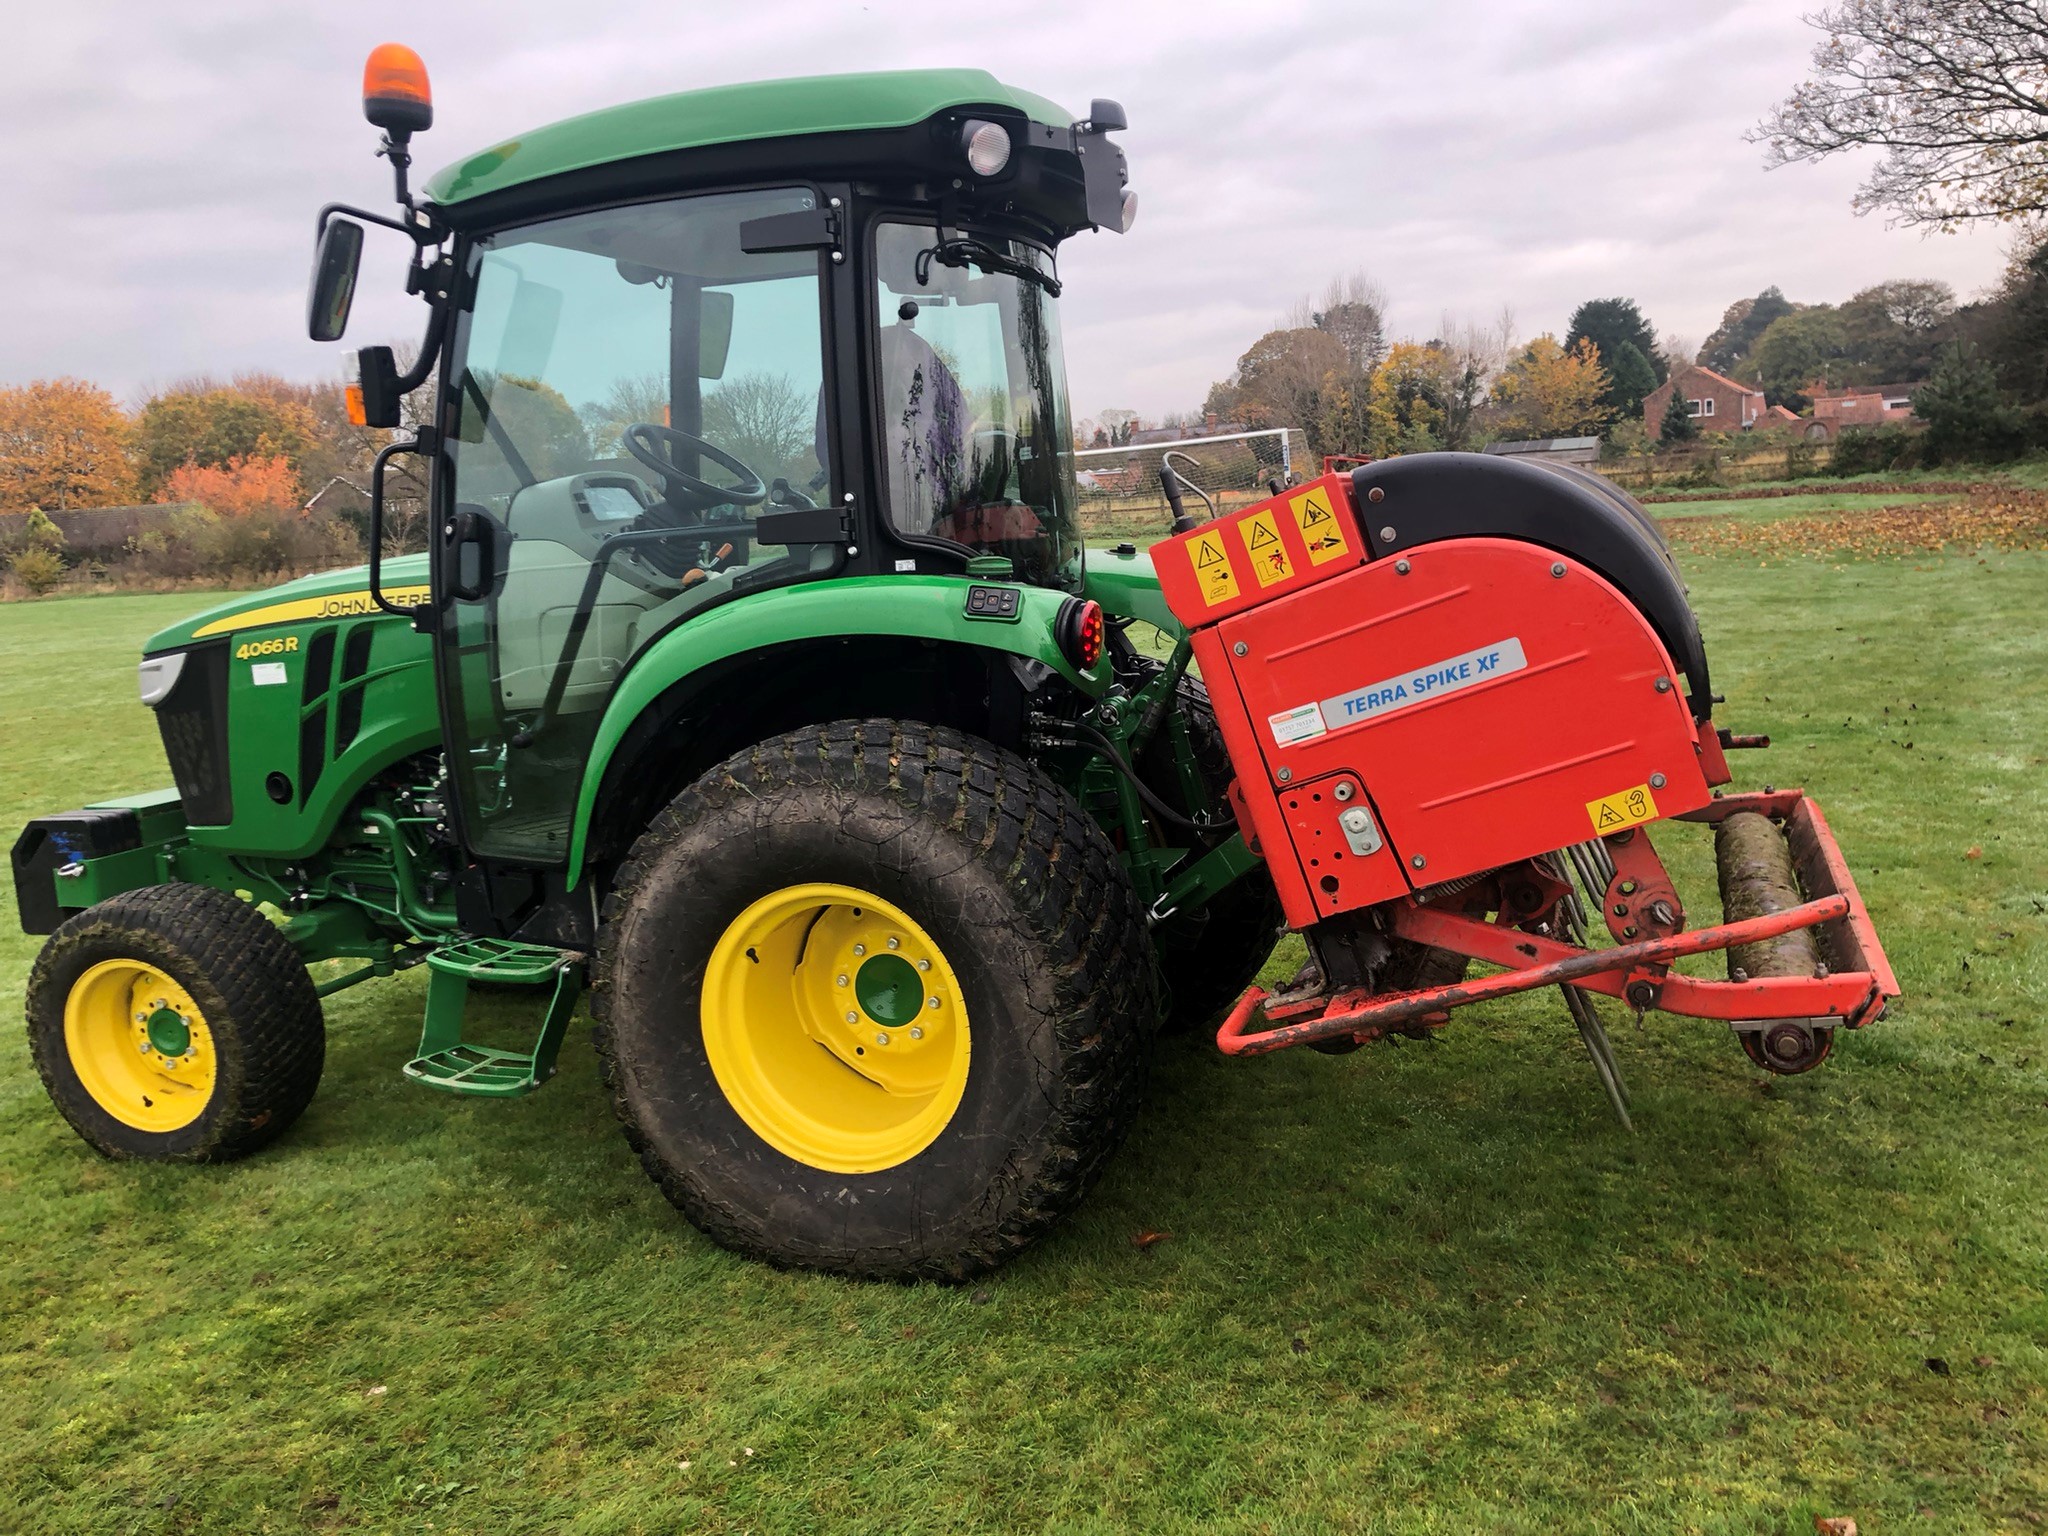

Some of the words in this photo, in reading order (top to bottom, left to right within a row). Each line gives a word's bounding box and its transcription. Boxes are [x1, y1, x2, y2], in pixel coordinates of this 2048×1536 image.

[317, 598, 366, 616] JOHN
[236, 636, 299, 660] 4066R
[1343, 685, 1408, 716] TERRA
[1412, 662, 1471, 694] SPIKE
[1476, 652, 1501, 674] XF
